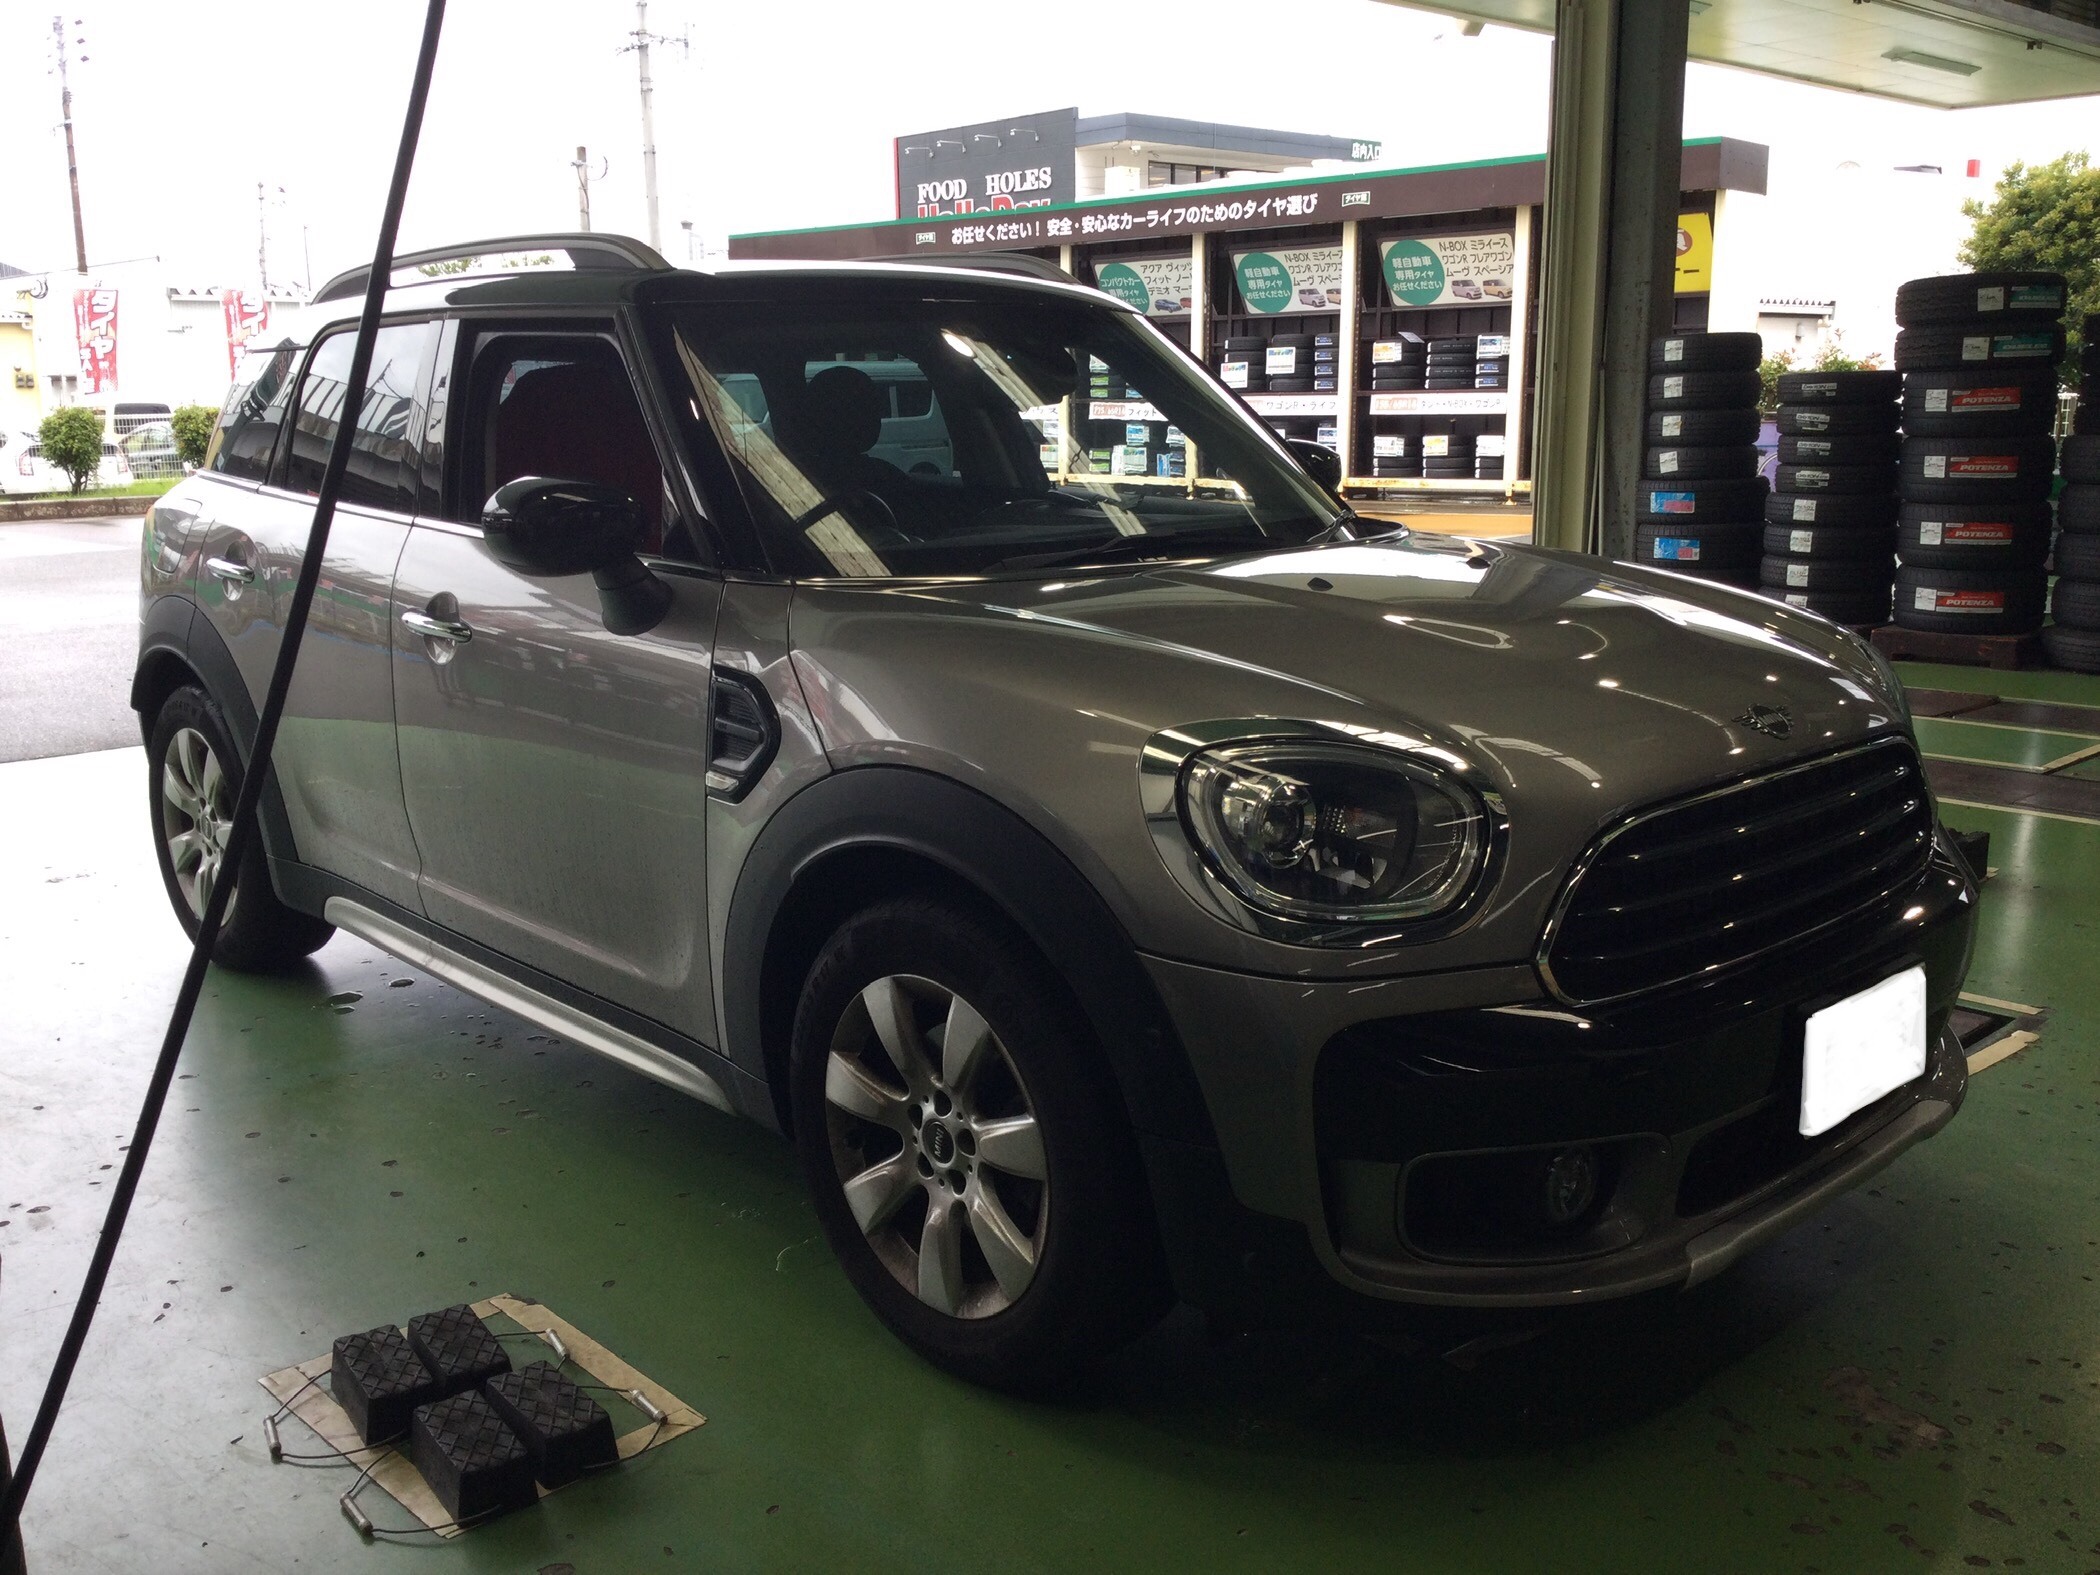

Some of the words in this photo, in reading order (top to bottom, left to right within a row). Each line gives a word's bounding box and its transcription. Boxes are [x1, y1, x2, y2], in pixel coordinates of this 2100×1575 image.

[1352, 142, 1381, 160] 店内入口
[917, 179, 967, 203] FOOD
[985, 167, 1052, 196] HOLES
[1439, 241, 1468, 252] N-BOX
[1470, 238, 1508, 250] ミライース
[1284, 252, 1311, 263] N-BOX
[1392, 256, 1433, 269] 軽自動車
[1442, 254, 1468, 264] ワゴンR
[1470, 251, 1513, 263] フレアワゴン
[1140, 264, 1162, 274] アクア
[1244, 266, 1280, 278] 軽自動車
[1289, 264, 1312, 274] ワゴンR
[1474, 264, 1515, 276] スペーシア
[1144, 275, 1171, 285] フィット
[1395, 270, 1434, 280] 専用タイヤ
[1248, 280, 1283, 290] 専用タイヤ
[1393, 280, 1443, 291] お任せください
[1962, 395, 2012, 404] POTENZA
[1955, 530, 2004, 538] POTENZA
